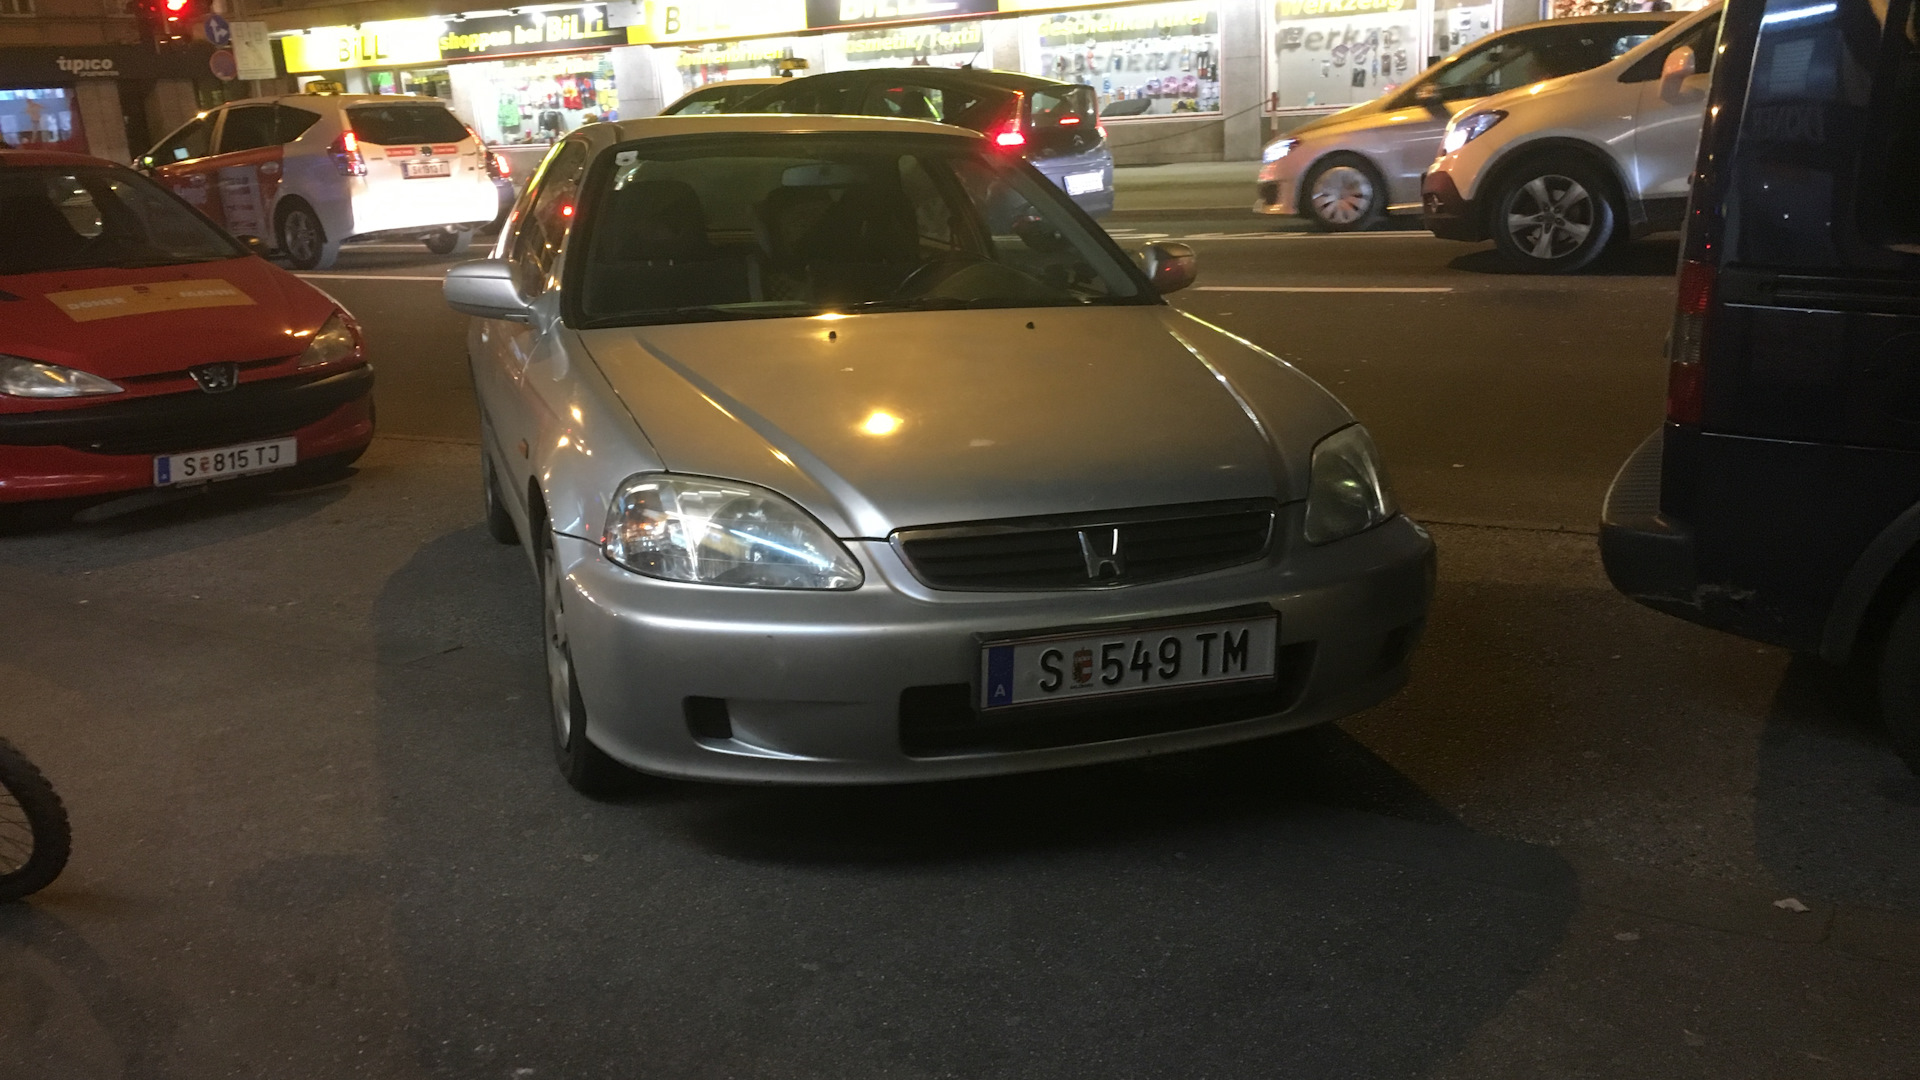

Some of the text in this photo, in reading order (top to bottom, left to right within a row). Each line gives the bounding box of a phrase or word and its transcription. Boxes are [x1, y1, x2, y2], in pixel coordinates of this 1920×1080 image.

[56, 55, 114, 75] tipico
[183, 445, 280, 476] S 815 TJ
[1038, 628, 1249, 693] S 549 TM
[994, 684, 1006, 698] A
